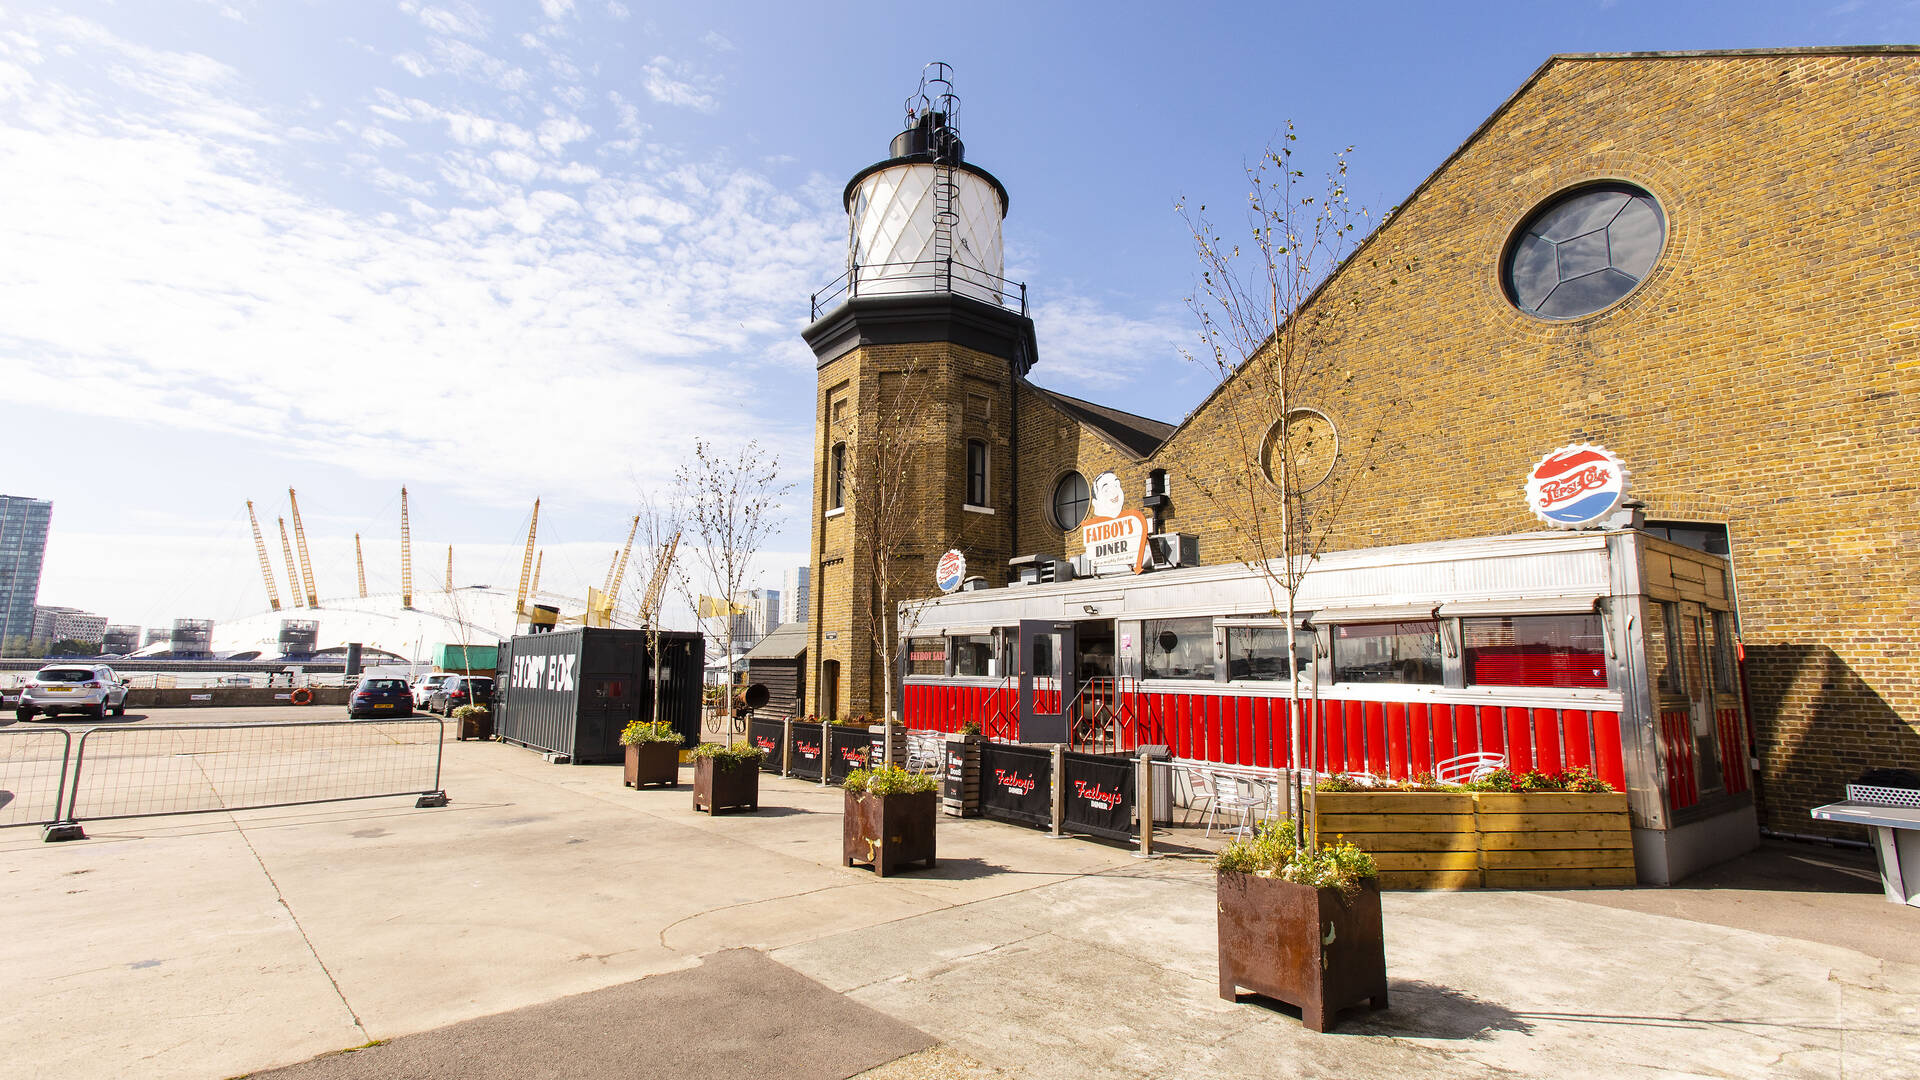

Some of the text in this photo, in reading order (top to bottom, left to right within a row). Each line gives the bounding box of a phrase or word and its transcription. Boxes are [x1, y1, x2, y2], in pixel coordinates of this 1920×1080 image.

[1085, 518, 1134, 544] FATBOY'S
[1095, 540, 1128, 558] DINER
[547, 653, 577, 692] BOX
[994, 768, 1035, 796] Fatboy's
[1073, 780, 1123, 811] Fatboy's
